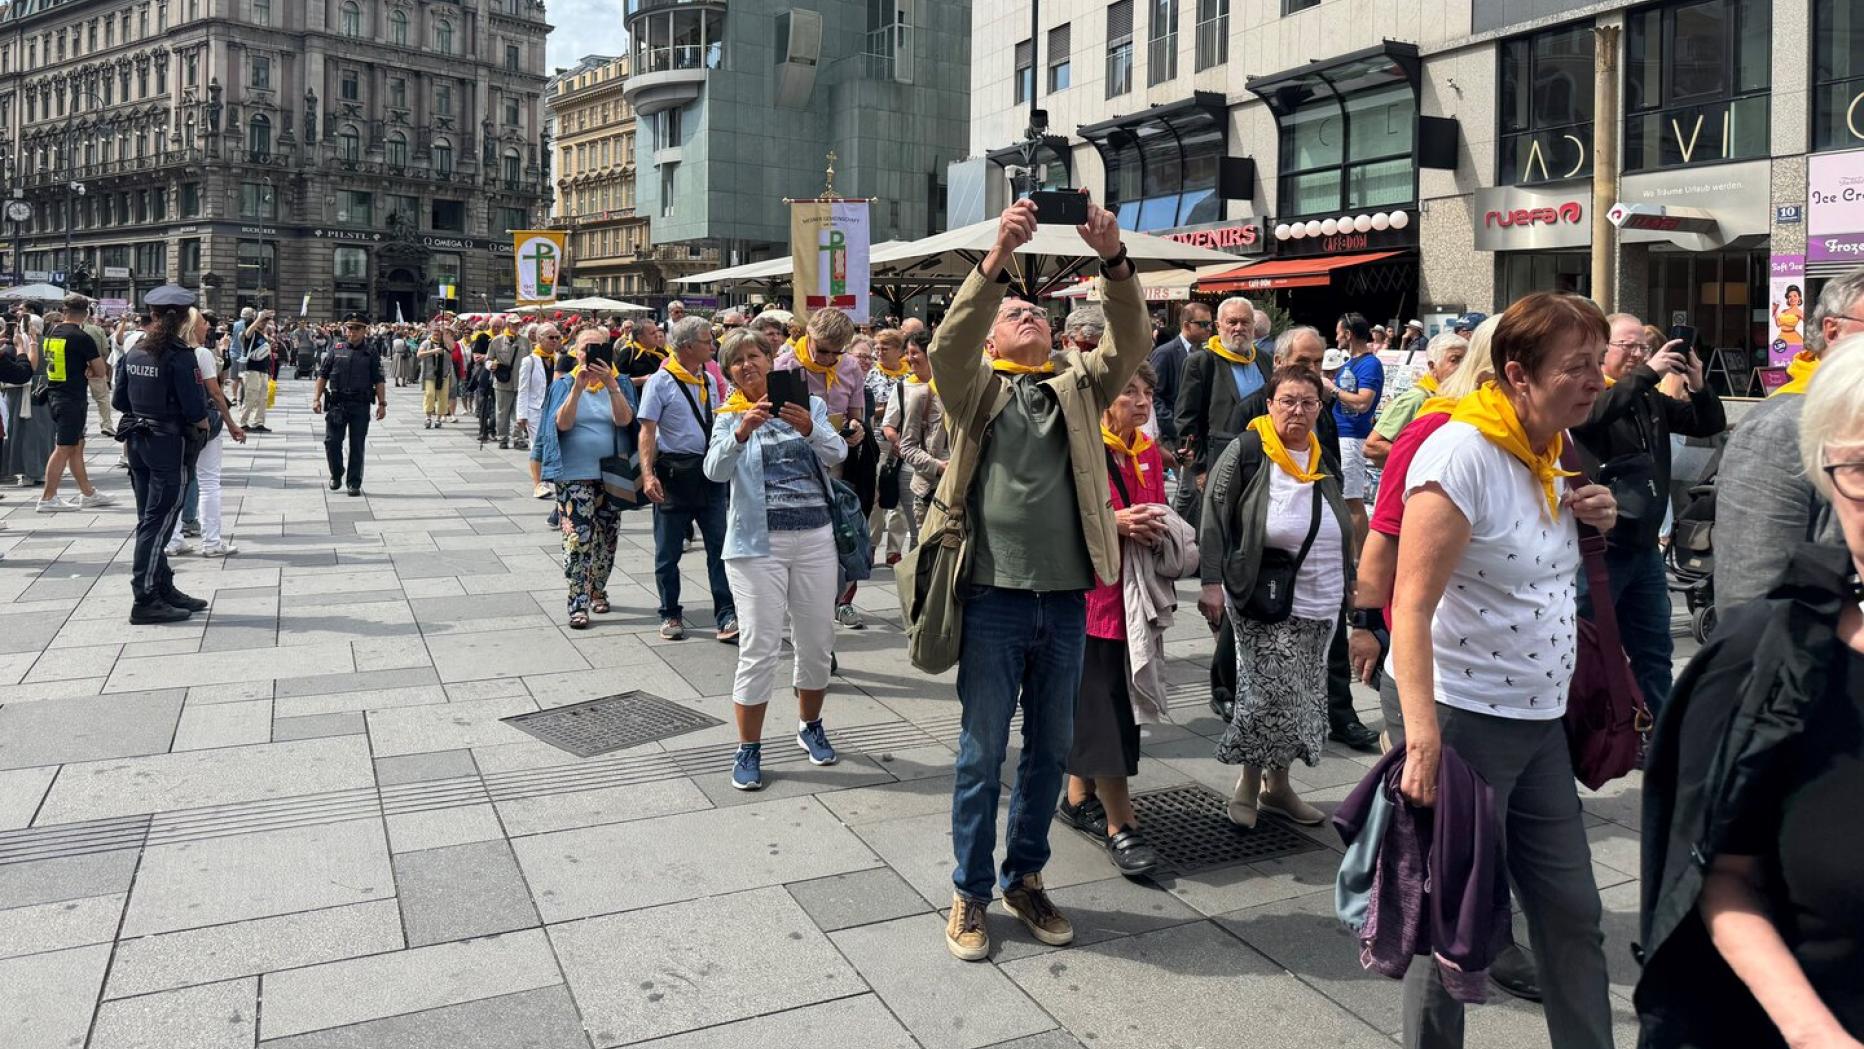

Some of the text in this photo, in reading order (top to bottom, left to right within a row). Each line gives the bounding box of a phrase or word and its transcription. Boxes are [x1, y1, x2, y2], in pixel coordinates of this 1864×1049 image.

[1685, 184, 1711, 194] Urlaub
[1812, 188, 1864, 205] Ice Cr
[1780, 207, 1795, 217] 10
[1485, 207, 1558, 229] ruefa
[328, 230, 369, 240] PILSTL
[434, 238, 463, 248] OMEGA
[1771, 262, 1803, 273] Soft Ice
[55, 273, 65, 283] U
[127, 364, 159, 378] POLIZEI
